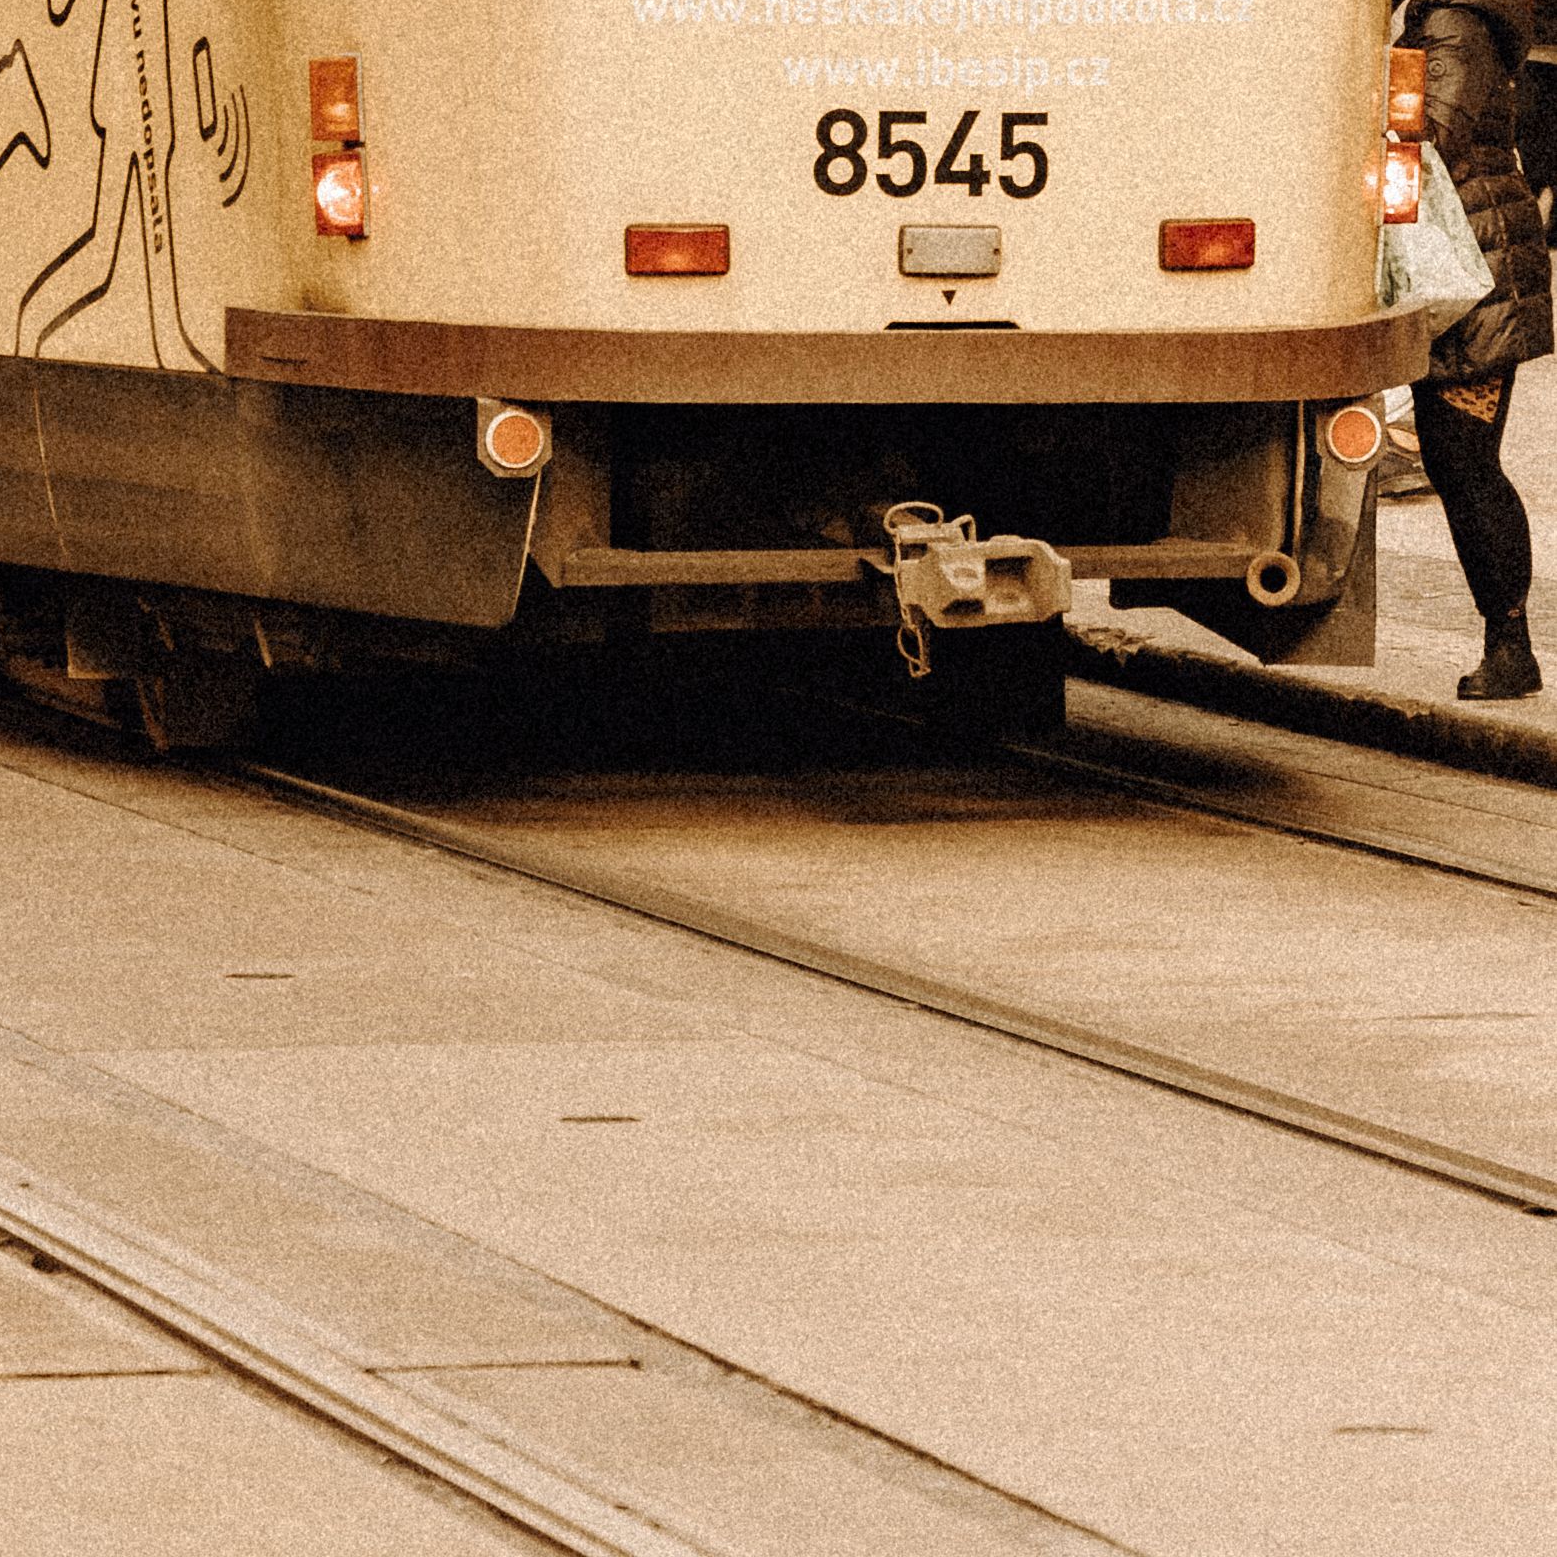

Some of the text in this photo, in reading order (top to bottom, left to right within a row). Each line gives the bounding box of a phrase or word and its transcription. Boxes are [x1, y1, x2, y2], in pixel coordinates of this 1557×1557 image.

[782, 46, 1111, 96] www.ibesip.cz
[136, 50, 164, 254] nedopsala
[812, 109, 1051, 199] 8545
